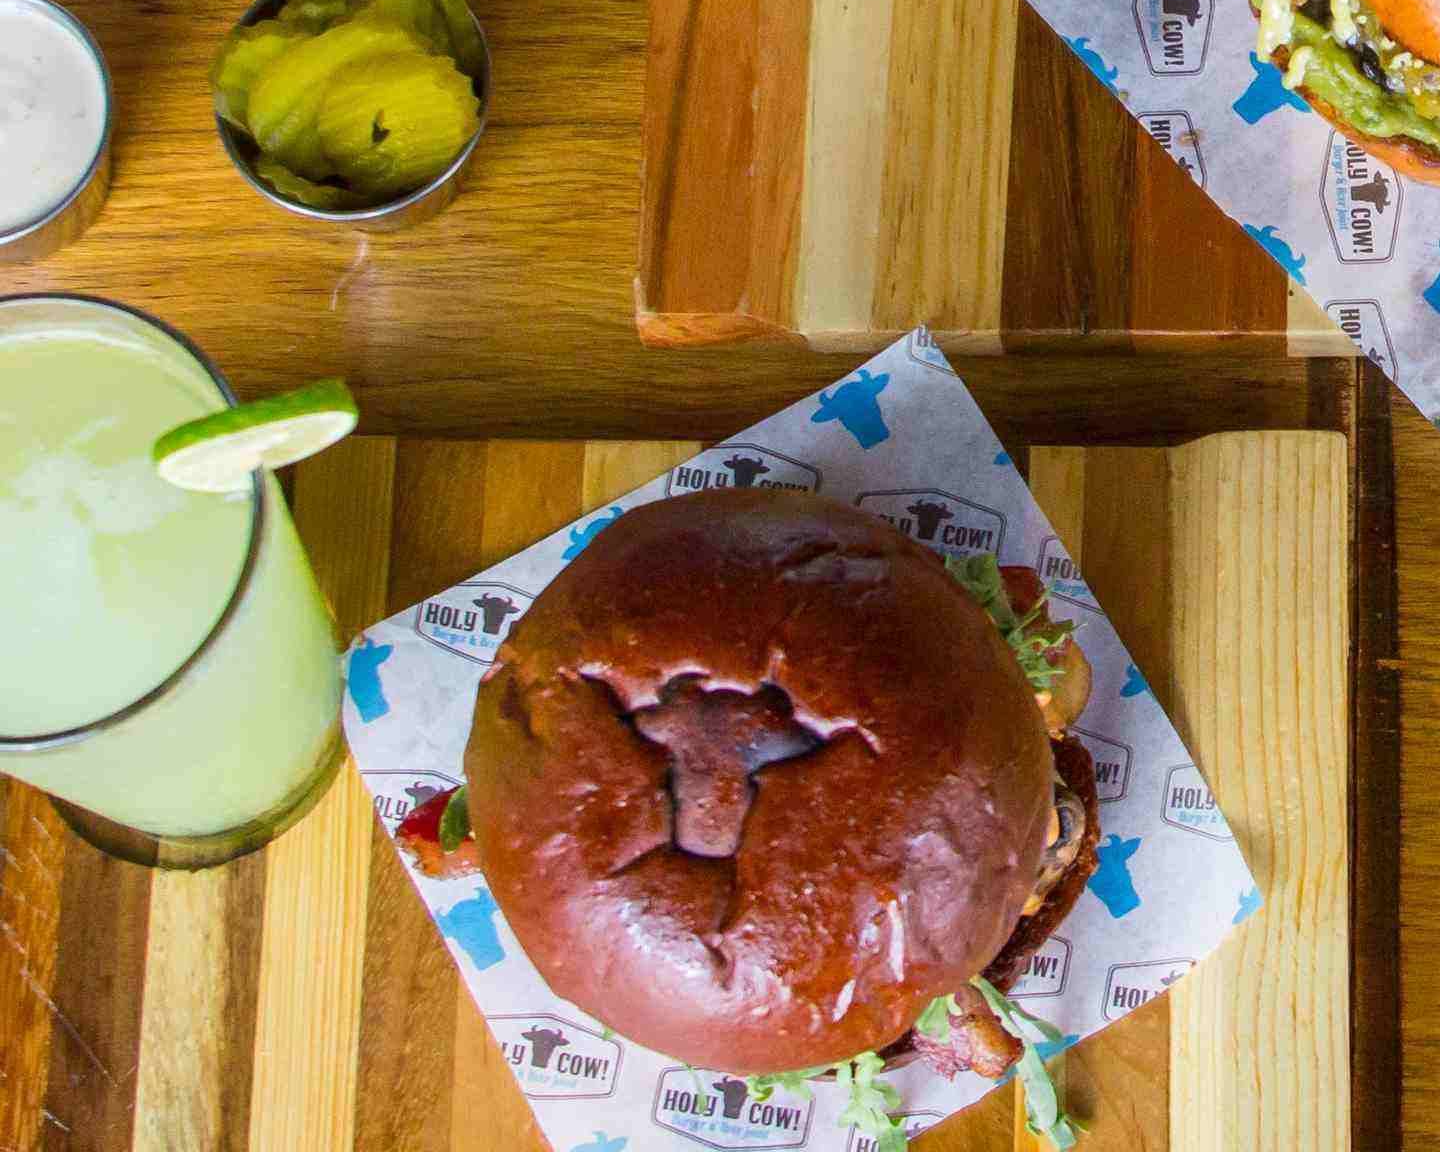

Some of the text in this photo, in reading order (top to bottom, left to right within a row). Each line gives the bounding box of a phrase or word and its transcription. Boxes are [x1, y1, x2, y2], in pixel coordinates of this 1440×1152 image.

[1162, 20, 1185, 66] COW!
[1351, 208, 1373, 253] COW!
[941, 524, 994, 551] COW!
[424, 603, 479, 632] HOLY
[558, 1052, 609, 1081] COW!
[663, 1089, 717, 1117] HOLY
[750, 1102, 802, 1131] COW!
